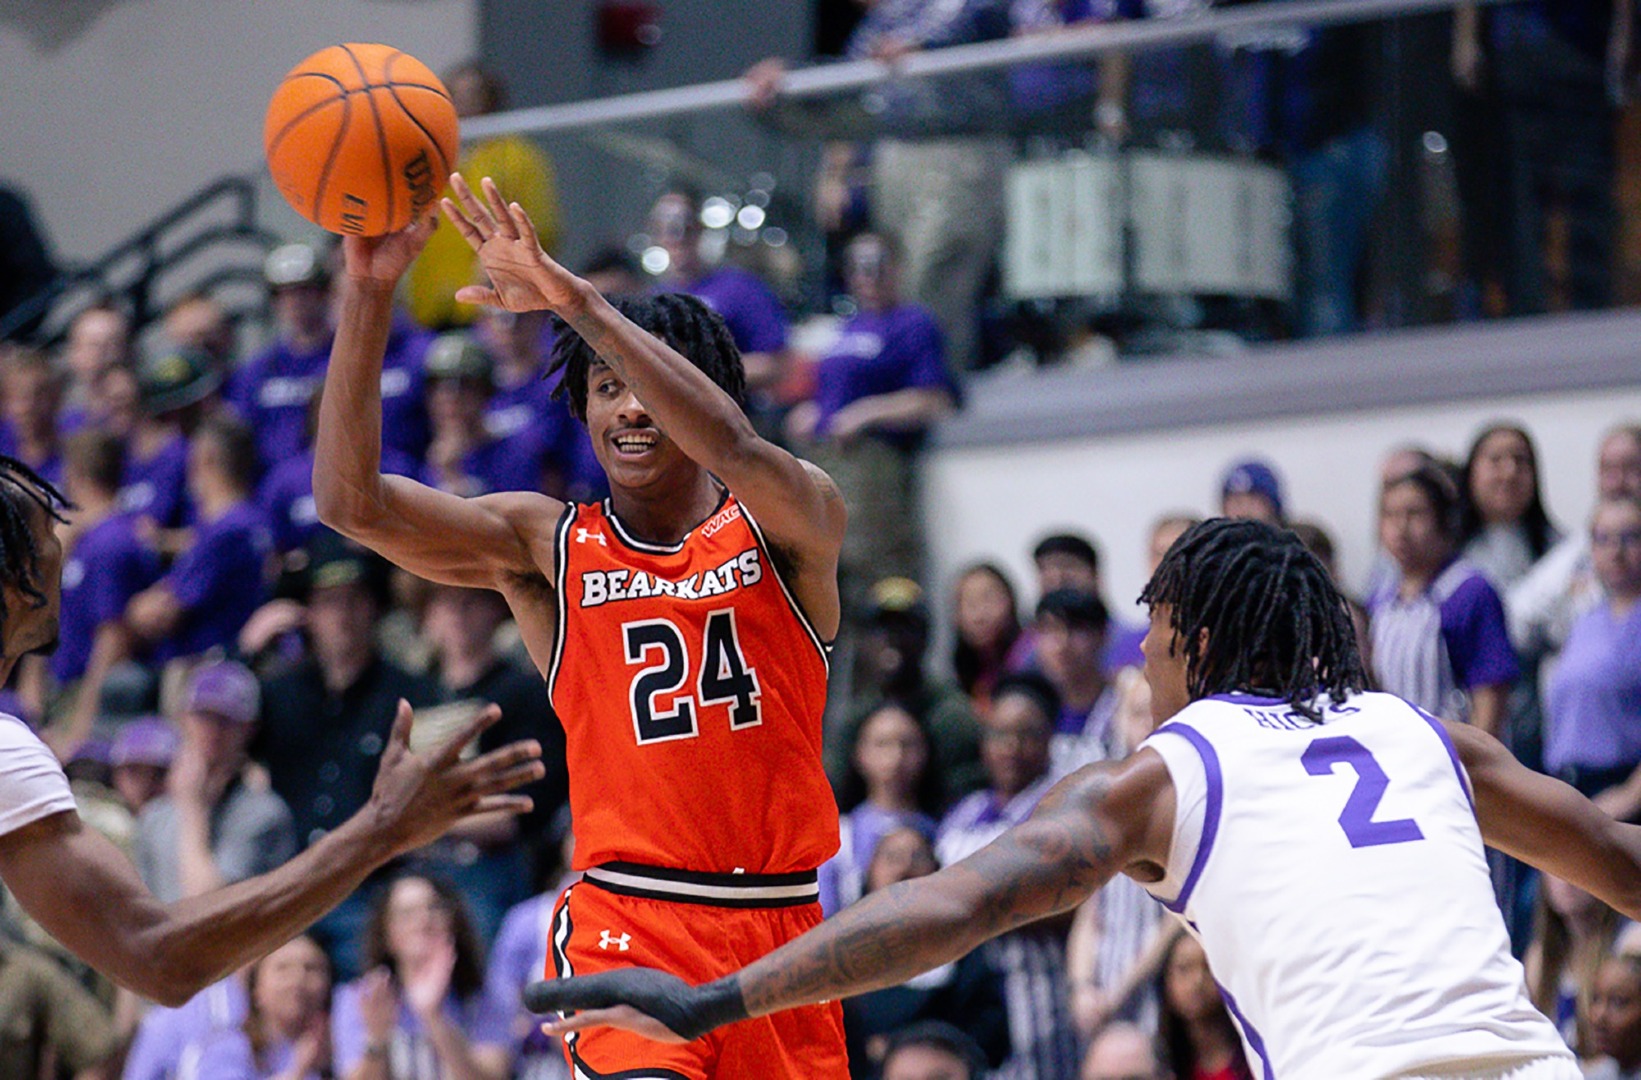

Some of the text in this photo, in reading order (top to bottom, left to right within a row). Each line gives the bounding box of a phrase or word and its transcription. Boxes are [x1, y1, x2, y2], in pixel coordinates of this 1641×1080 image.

[701, 503, 741, 538] WAC
[581, 548, 762, 608] BEARKATS
[621, 607, 763, 746] 24
[1300, 735, 1426, 848] 2
